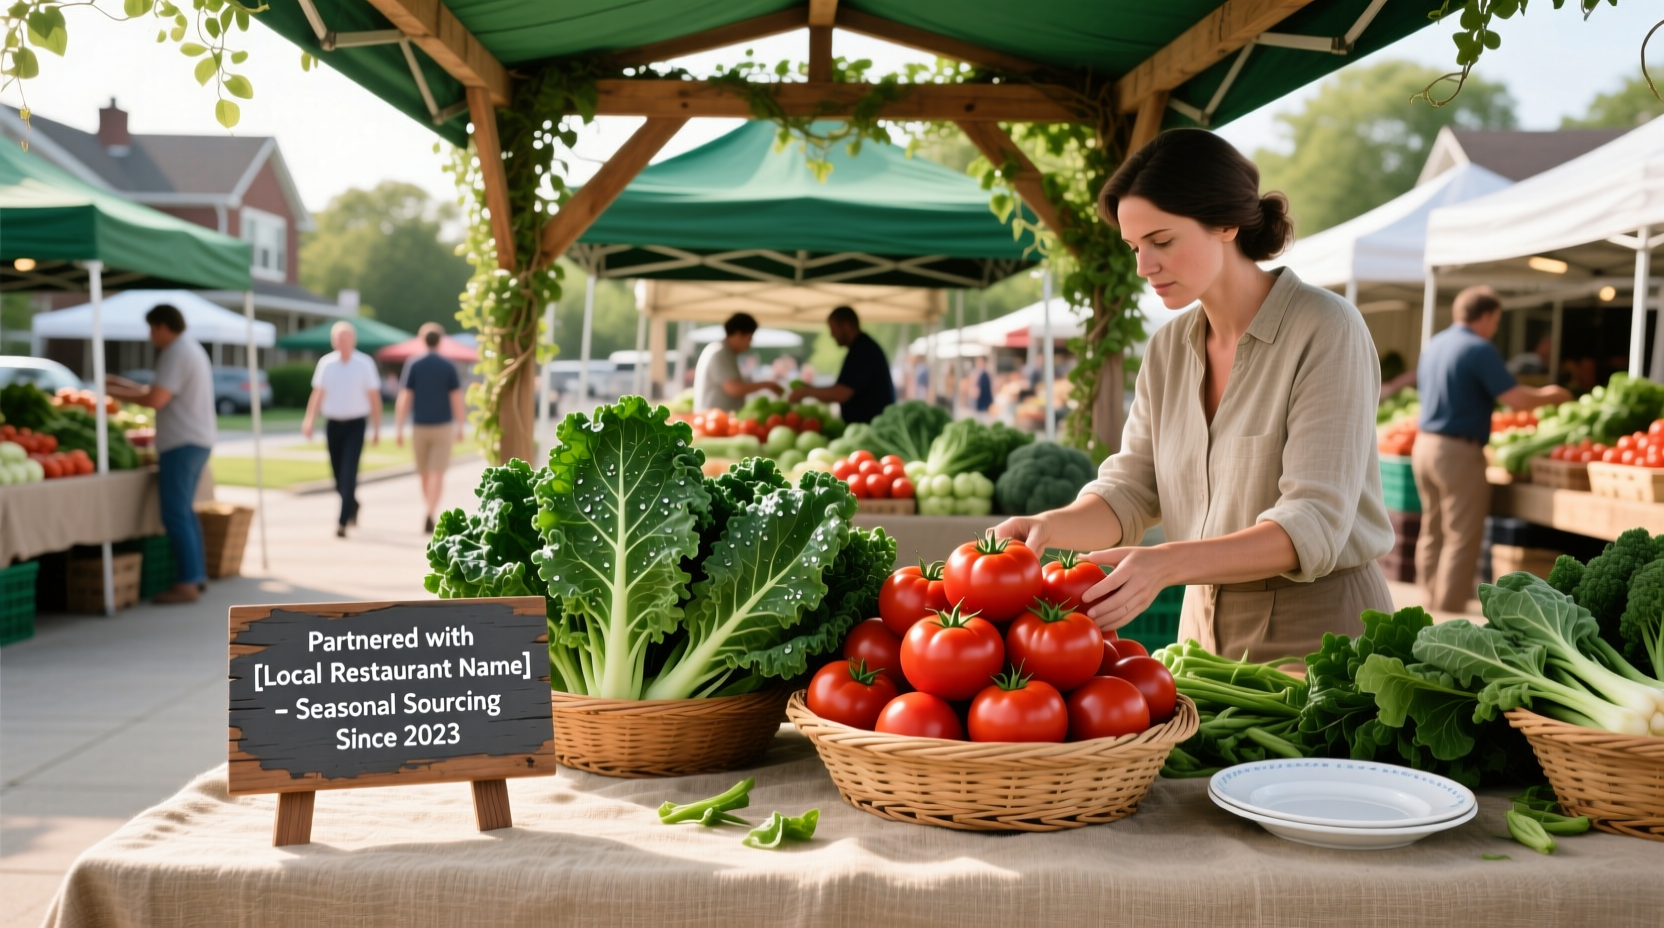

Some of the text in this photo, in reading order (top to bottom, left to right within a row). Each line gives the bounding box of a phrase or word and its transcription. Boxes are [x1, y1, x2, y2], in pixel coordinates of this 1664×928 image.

[308, 624, 474, 652] Partnered with
[253, 651, 532, 692] [Local Restaurant Name]
[295, 692, 396, 720] Seasonal
[403, 689, 502, 717] Sourcing
[336, 722, 461, 750] Since 2023
